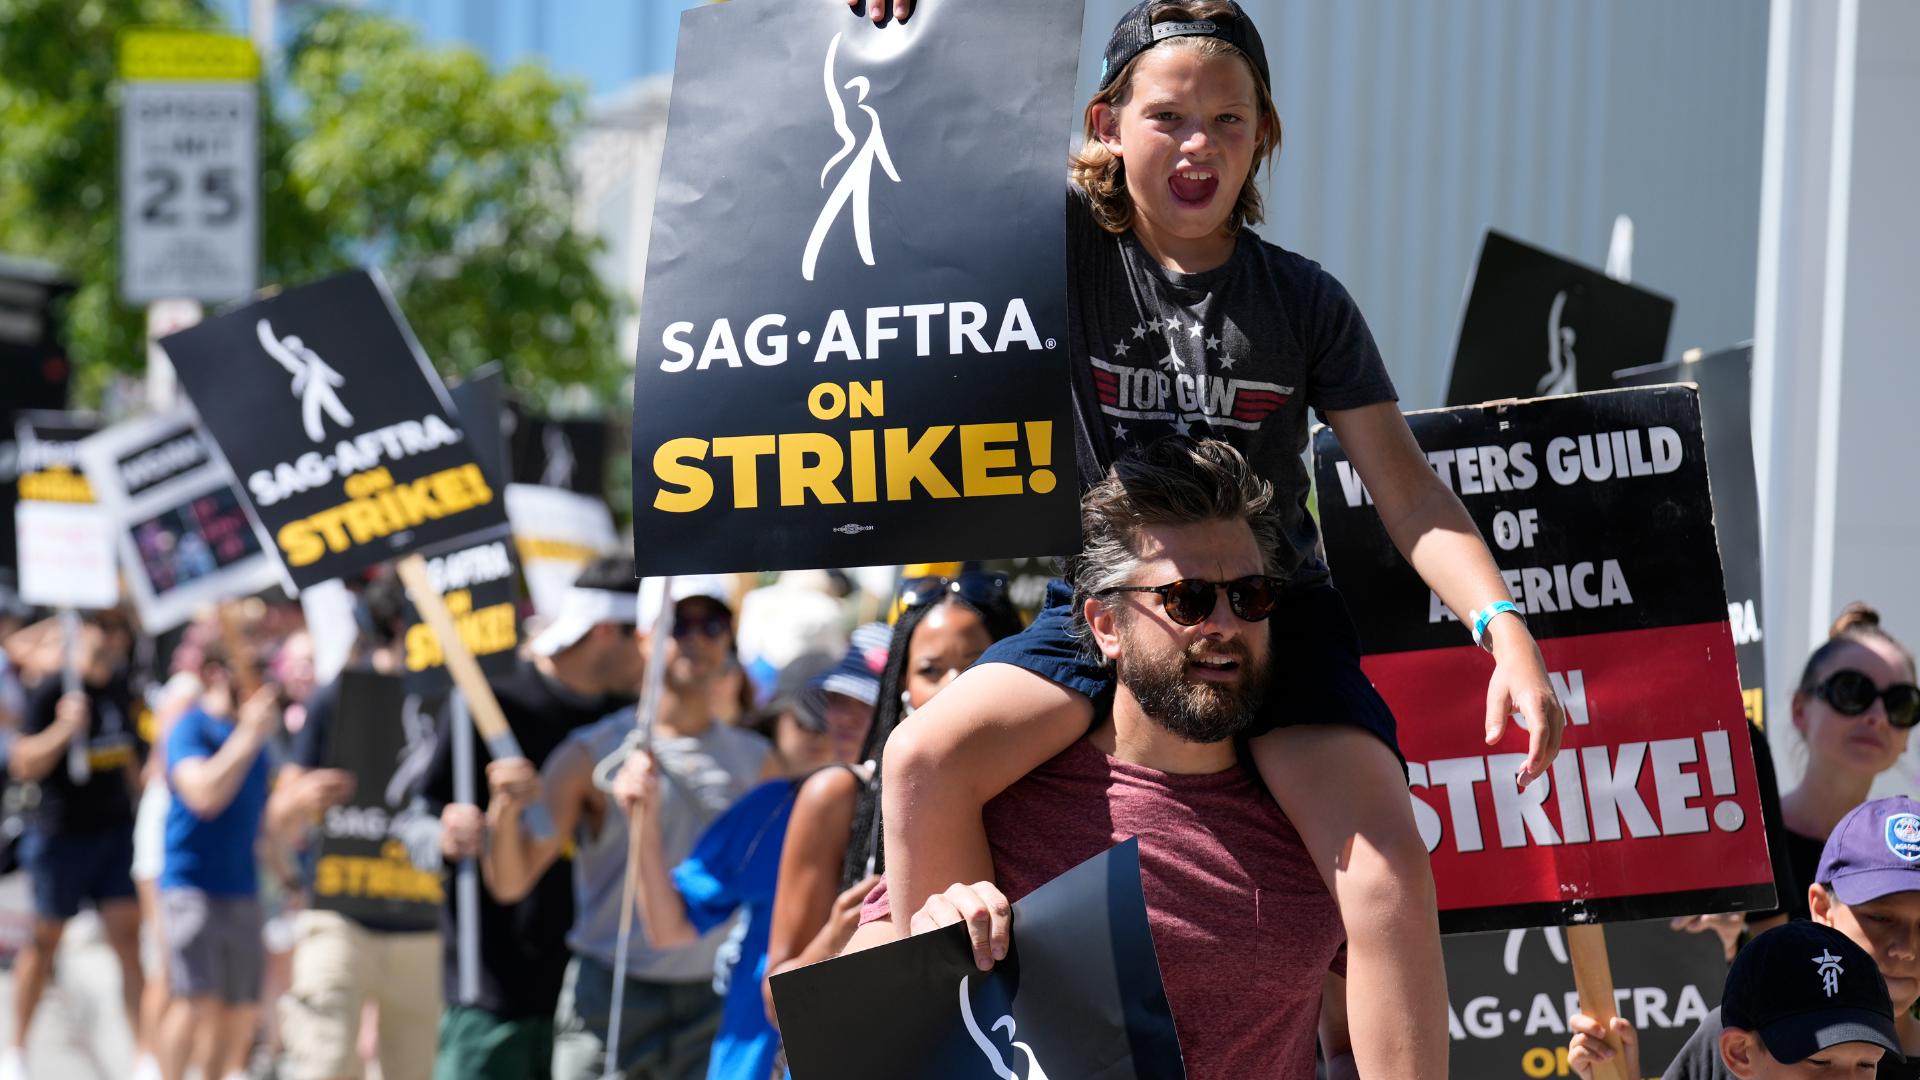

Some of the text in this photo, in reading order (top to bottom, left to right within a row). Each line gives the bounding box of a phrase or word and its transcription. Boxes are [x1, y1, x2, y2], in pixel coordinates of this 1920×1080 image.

[141, 166, 241, 229] 25
[807, 380, 884, 420] ON
[1116, 367, 1237, 417] TOP GUN
[652, 420, 1057, 513] STRIKE!
[1546, 426, 1683, 486] GUILD
[277, 463, 493, 567] STRIKE!
[1493, 508, 1539, 550] OF
